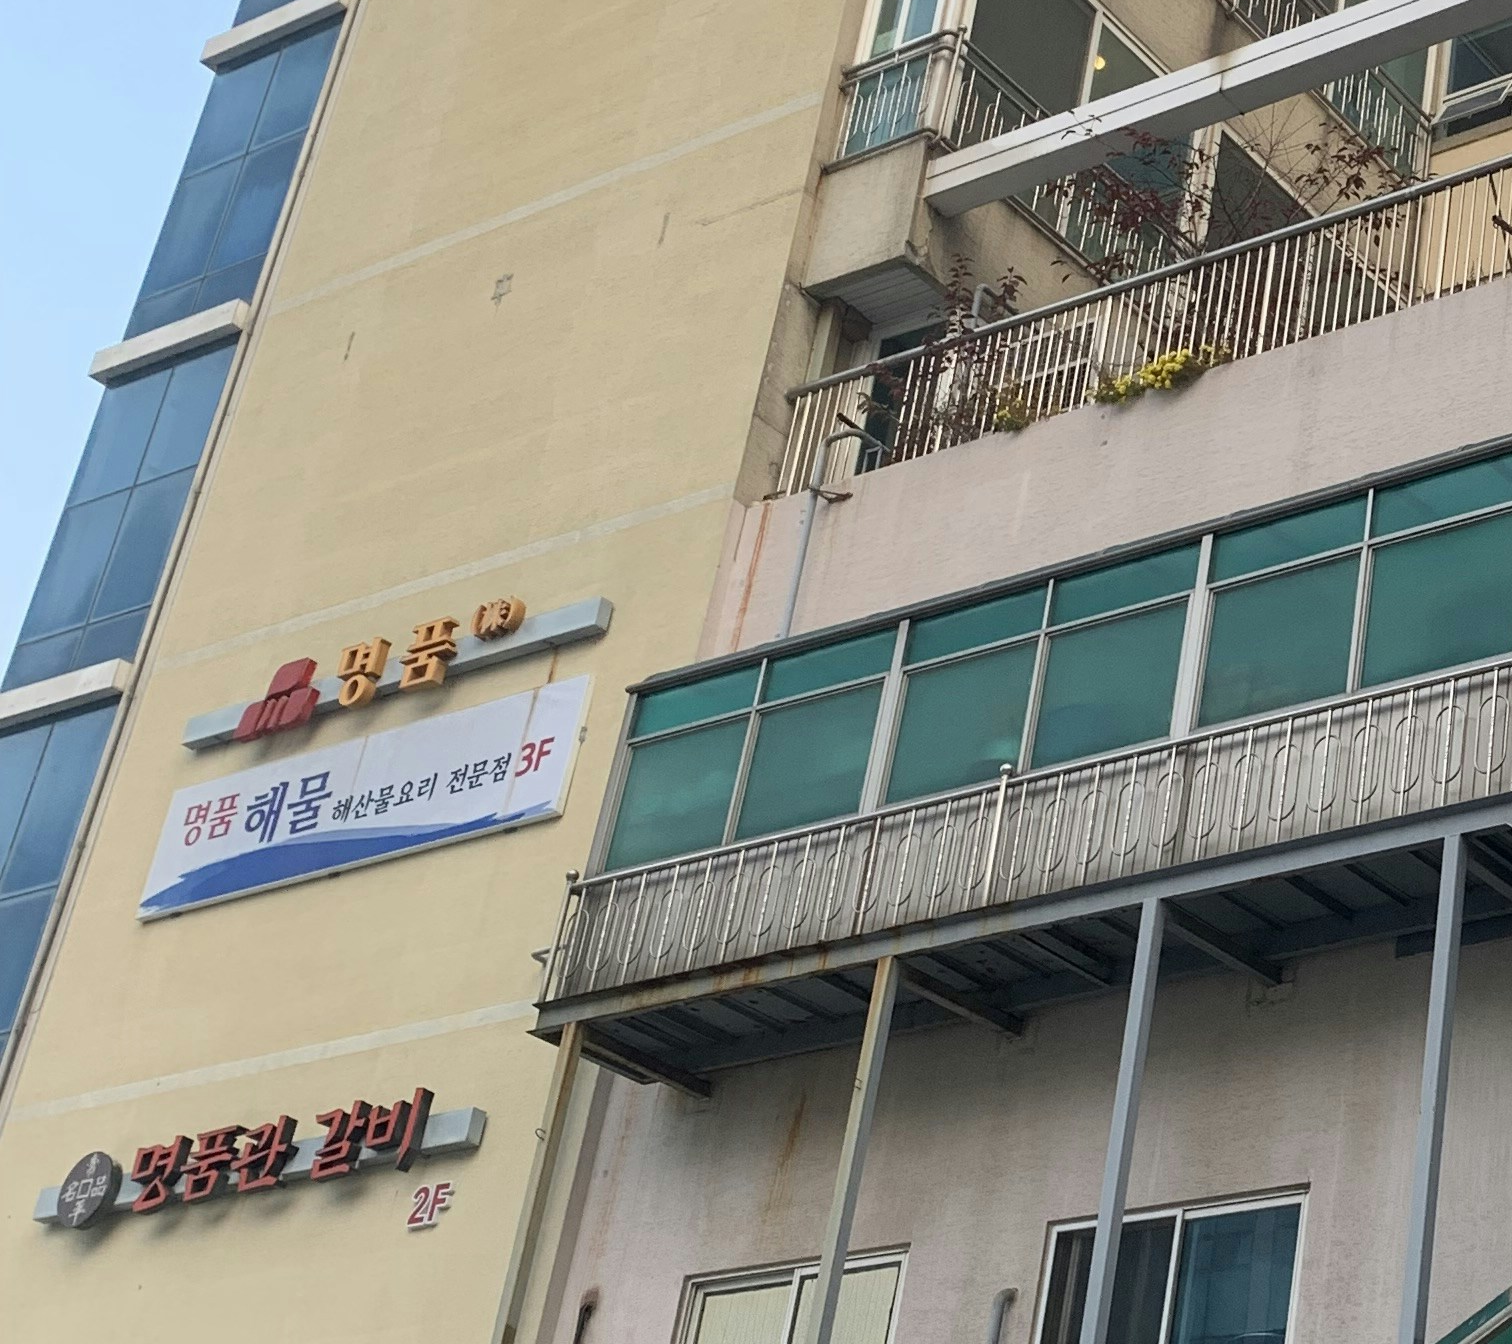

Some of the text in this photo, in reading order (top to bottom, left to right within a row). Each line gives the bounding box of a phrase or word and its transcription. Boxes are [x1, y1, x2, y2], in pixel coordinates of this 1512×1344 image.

[184, 737, 555, 846] 명품 해물 해산물요리 전문점 3F
[131, 1087, 434, 1214] 명품관 갈비
[407, 1181, 454, 1230] 2F
